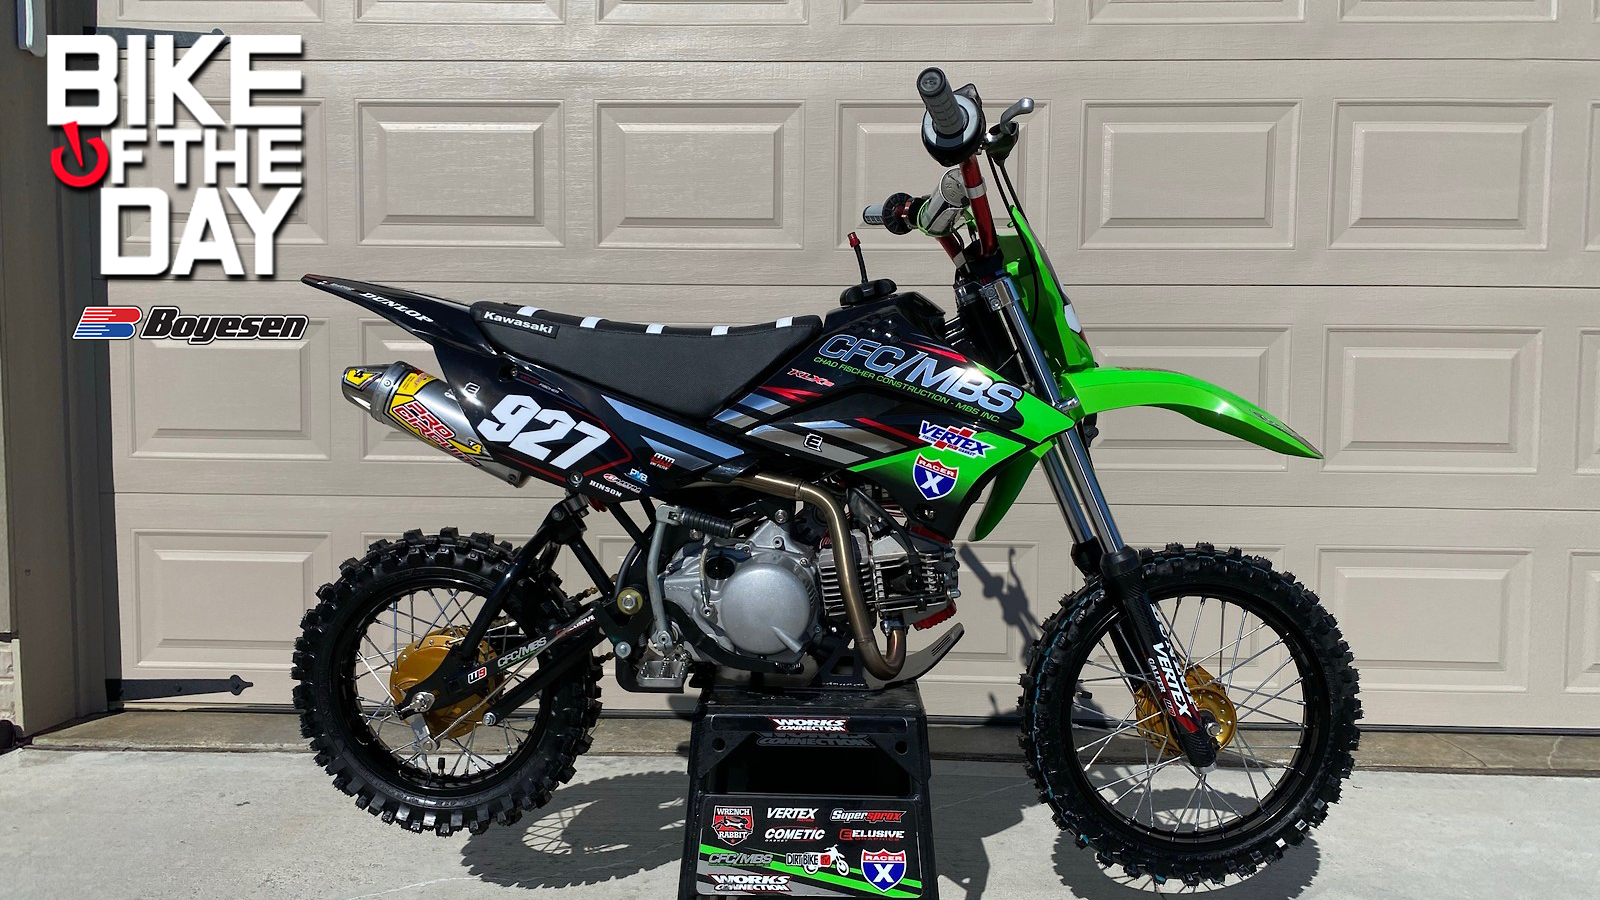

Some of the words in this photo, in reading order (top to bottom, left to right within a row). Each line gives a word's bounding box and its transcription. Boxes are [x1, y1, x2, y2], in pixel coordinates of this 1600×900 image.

[360, 292, 434, 323] DUNLOP
[484, 311, 554, 335] Kawasaki
[818, 334, 1023, 414] CFC/MBS
[813, 356, 839, 368] CHAD
[839, 363, 875, 380] FISCHER
[876, 375, 950, 405] CONSTRUCTION
[955, 401, 980, 415] MBS
[406, 401, 456, 440] PRO
[477, 394, 611, 470] 927
[919, 421, 991, 456] VERTEX
[918, 459, 955, 477] RACER
[589, 480, 622, 497] HINSON
[919, 470, 945, 495] X
[498, 637, 547, 667] CFC/MBS
[1153, 642, 1193, 718] VERTEX
[772, 718, 848, 726] WORKS
[716, 808, 750, 816] WRENCH
[767, 807, 819, 819] VERTEX
[831, 808, 904, 823] Supersprox
[718, 831, 749, 839] RABBIT
[764, 828, 825, 840] COMETIC
[851, 830, 905, 839] ELUSIVE
[708, 852, 773, 865] CFC/MBS
[785, 852, 803, 866] DIRT
[802, 852, 819, 866] BIKE
[711, 875, 792, 884] WORKS
[873, 864, 895, 883] X
